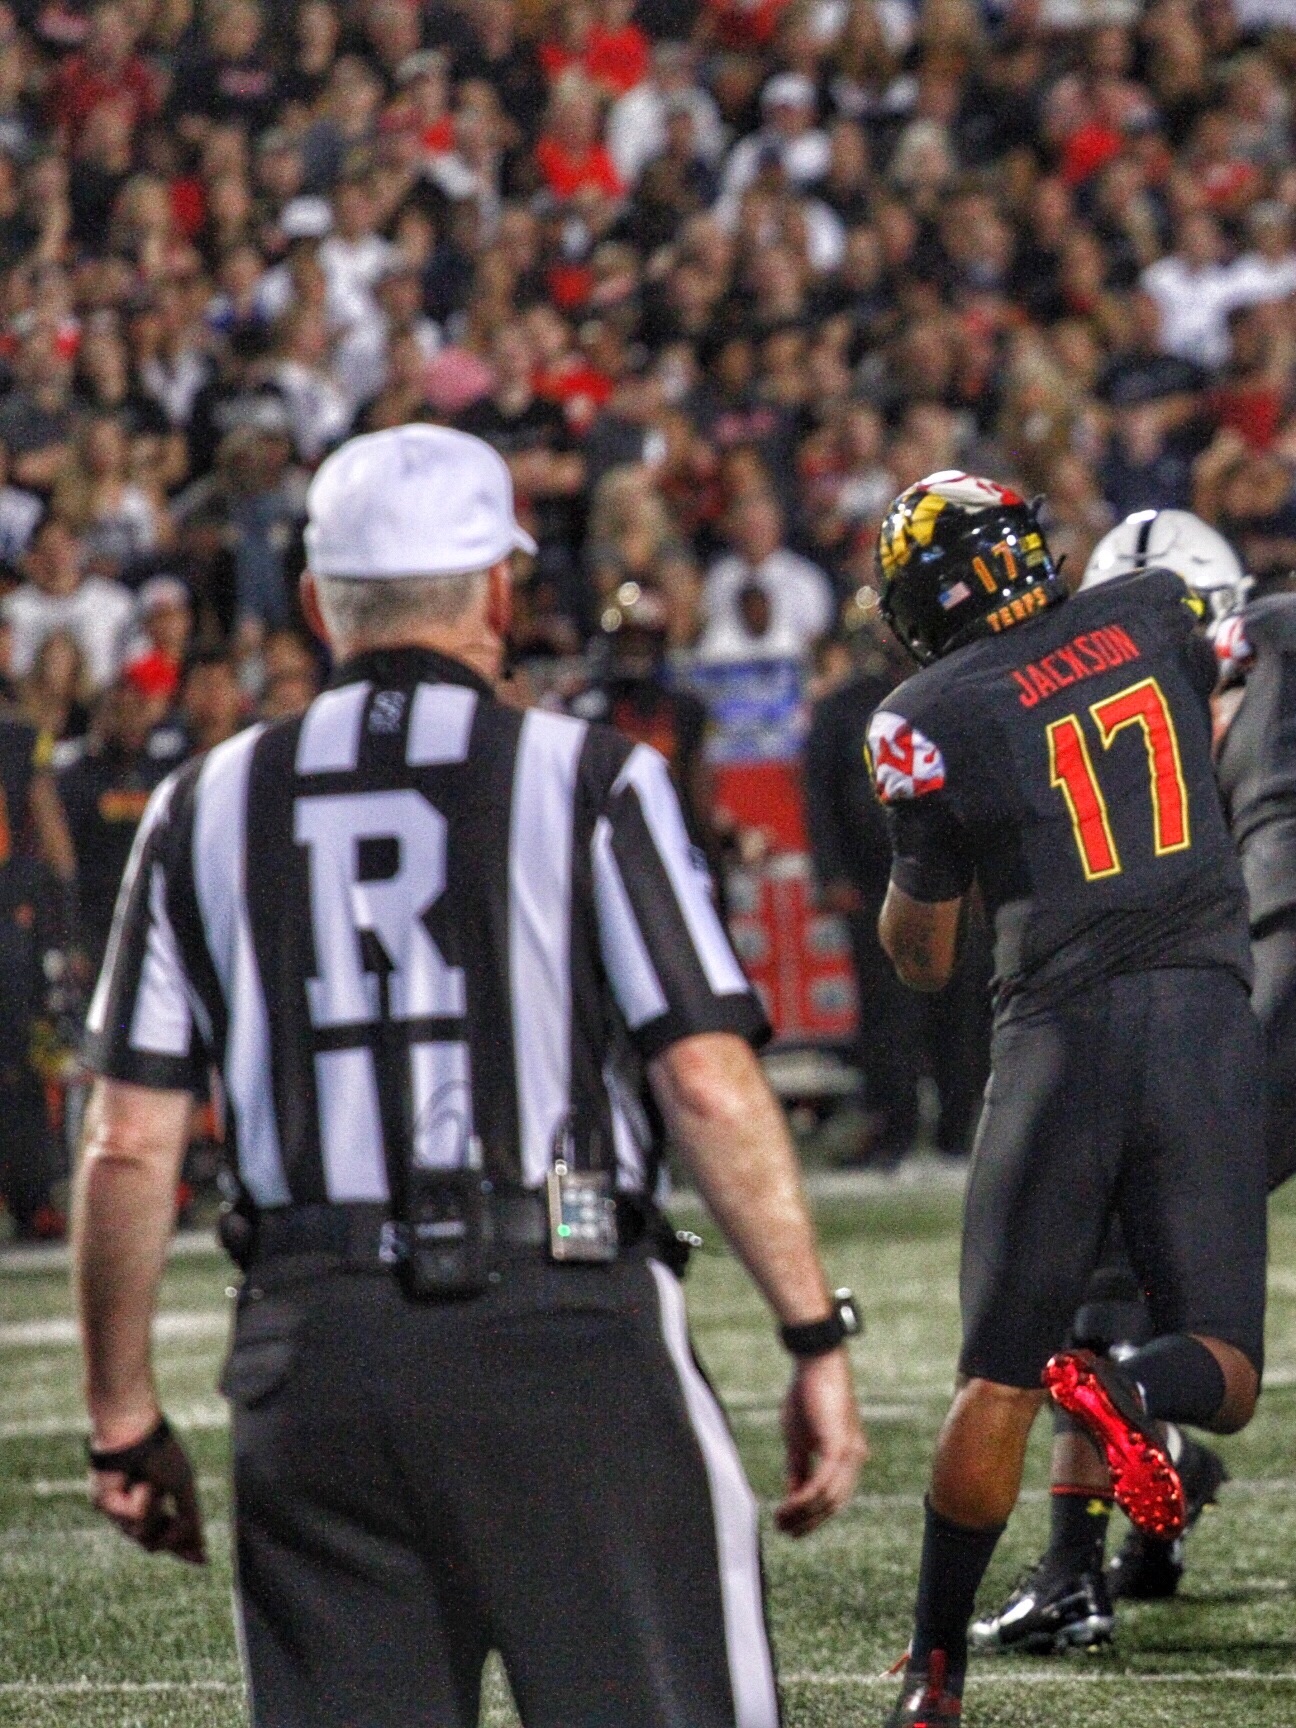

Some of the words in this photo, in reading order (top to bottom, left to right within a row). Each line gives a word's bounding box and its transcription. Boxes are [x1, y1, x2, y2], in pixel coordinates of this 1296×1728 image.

[972, 540, 1018, 594] 17
[986, 586, 1048, 632] TERPS
[1012, 624, 1141, 707] JACKSON
[1046, 677, 1191, 882] 17
[294, 787, 468, 1029] R
